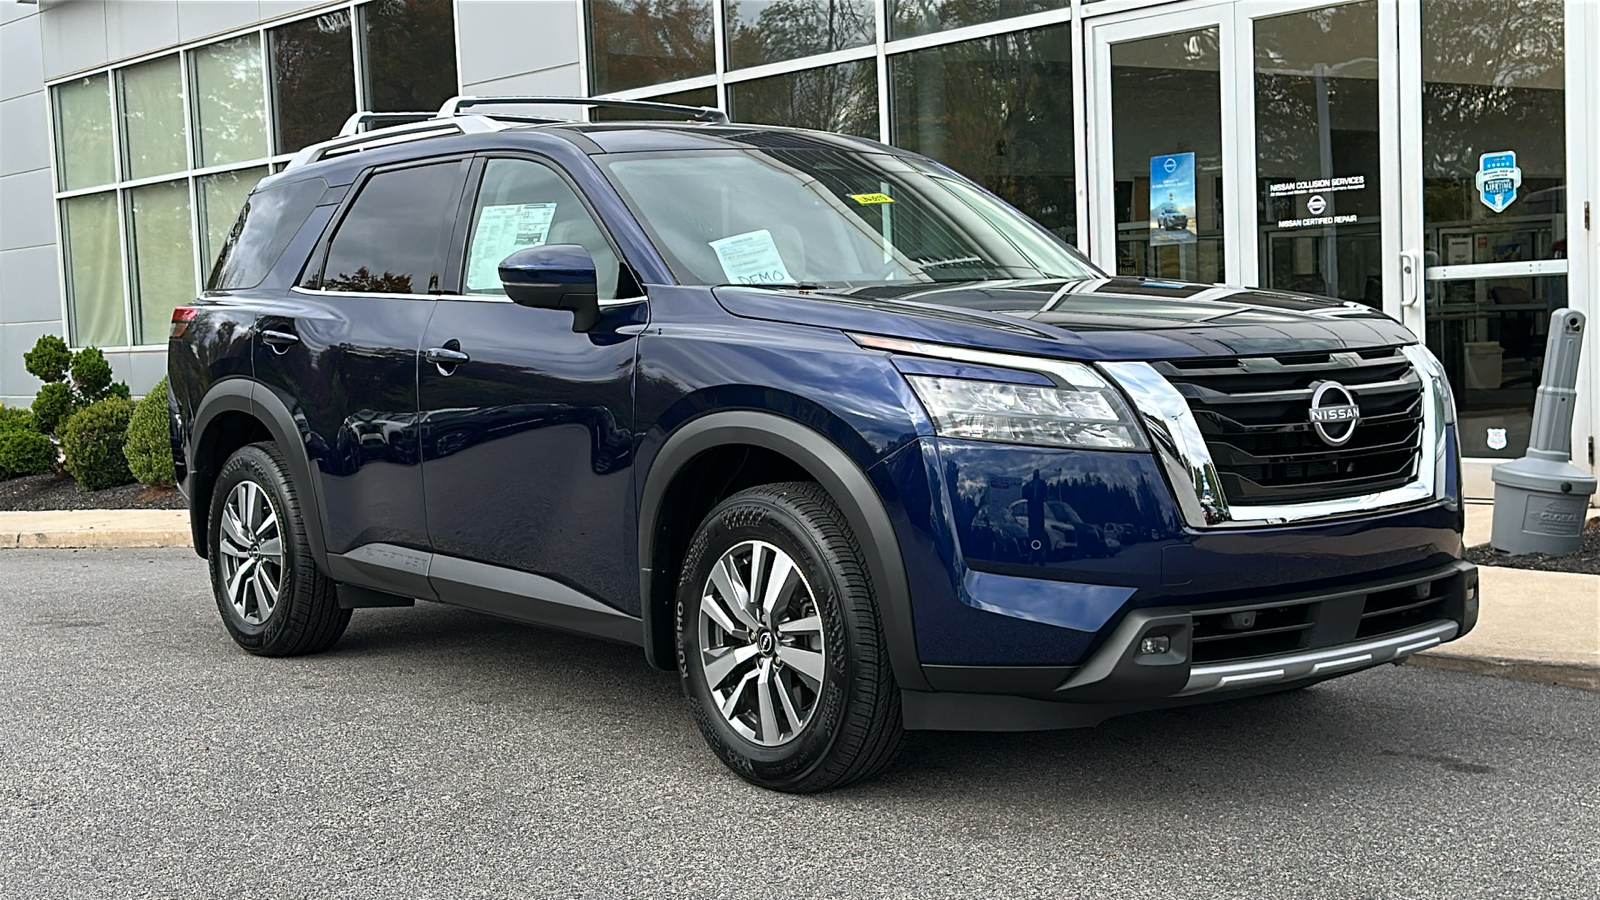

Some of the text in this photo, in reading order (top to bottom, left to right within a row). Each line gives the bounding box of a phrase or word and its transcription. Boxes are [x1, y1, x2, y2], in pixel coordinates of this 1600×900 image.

[1270, 176, 1365, 192] NISSAN COLLISION SERVICES
[1485, 182, 1513, 192] LIFETIME
[1278, 214, 1357, 228] NISSAN CERTIFIED REPAIR
[737, 270, 785, 285] DEMO
[1311, 407, 1360, 421] NISSAN
[676, 601, 689, 678] KUMHO
